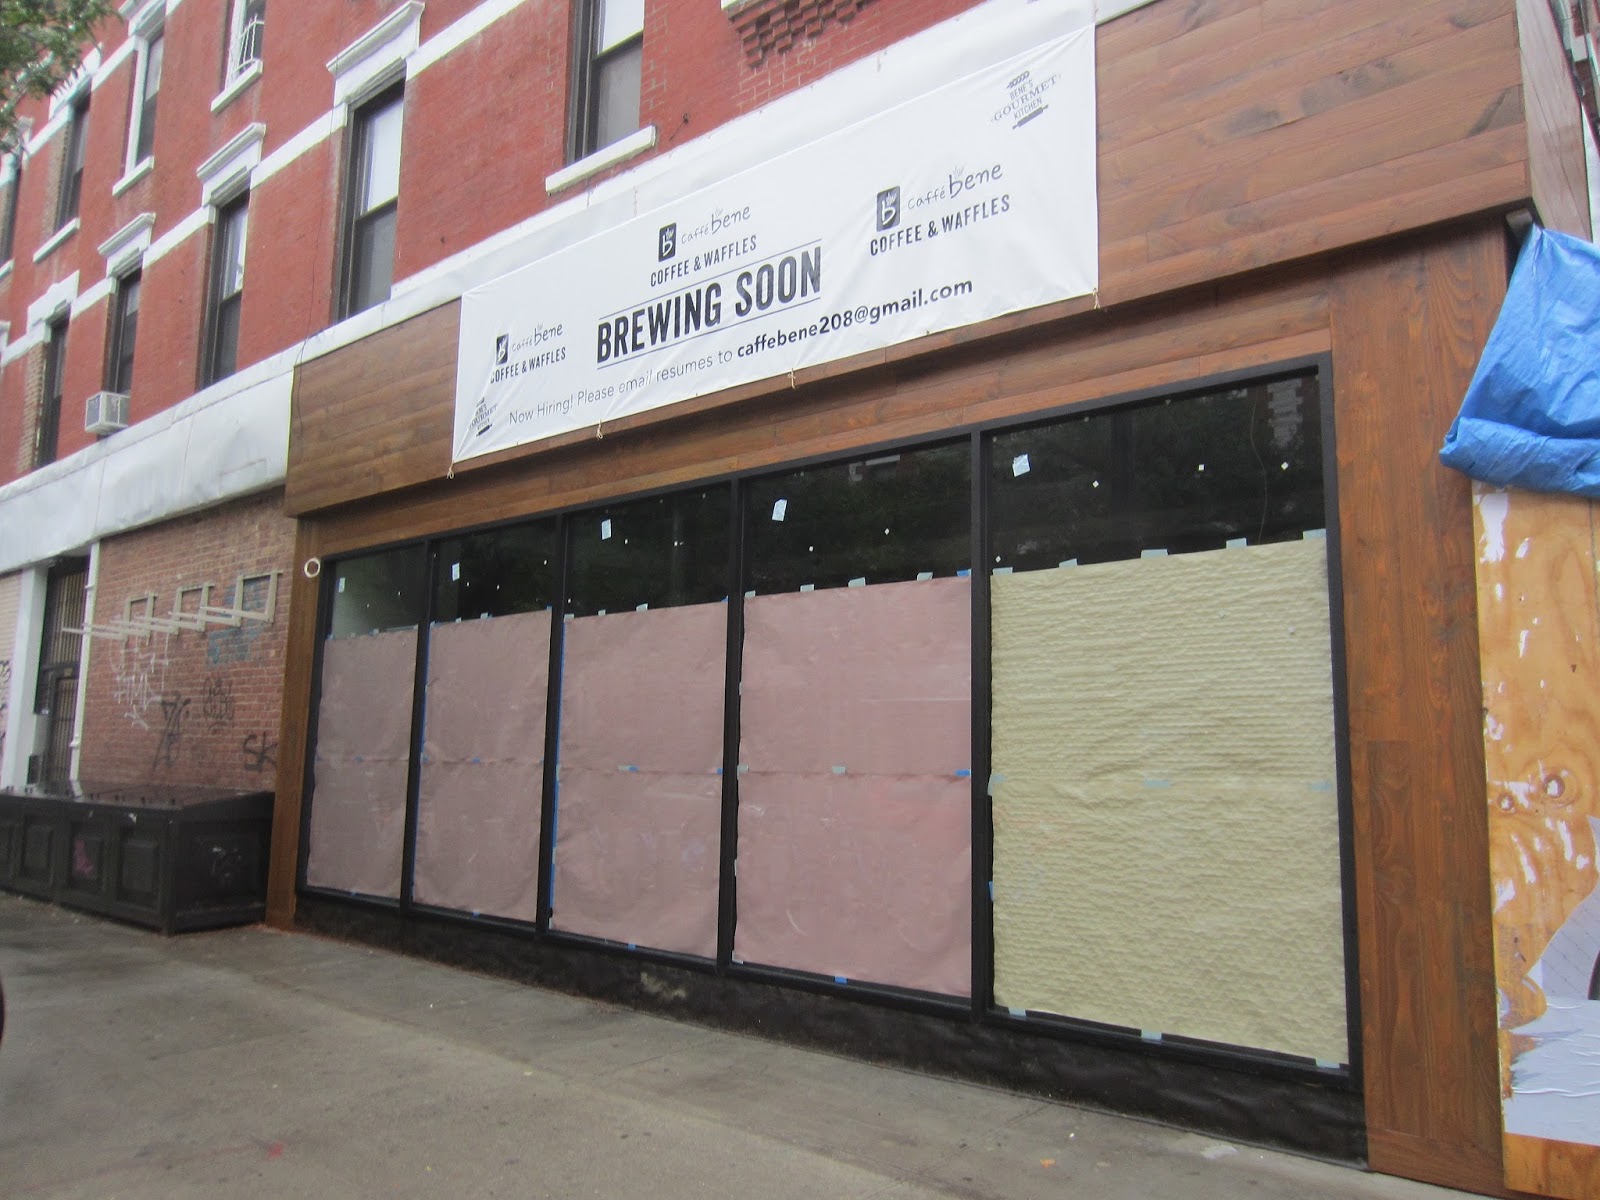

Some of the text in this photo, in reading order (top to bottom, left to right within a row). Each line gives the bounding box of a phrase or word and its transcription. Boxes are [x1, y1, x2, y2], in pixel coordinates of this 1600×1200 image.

[993, 74, 1058, 121] GOURMET
[1013, 97, 1042, 120] KITCHEN
[949, 164, 1003, 199] bene
[711, 206, 751, 234] bene
[870, 194, 1010, 256] COFFEE & WAFFLES
[650, 235, 757, 287] COFFEE & WAFFLES
[597, 246, 822, 363] BREWING SOON
[509, 410, 534, 426] Now
[537, 394, 573, 415] Hiring!
[577, 384, 614, 406] Please
[618, 369, 652, 392] email
[656, 356, 713, 382] resumes
[718, 350, 733, 364] to
[737, 279, 973, 358] caffebene208@gmail.com
[521, 360, 527, 373] &
[528, 346, 566, 371] WAFFLES
